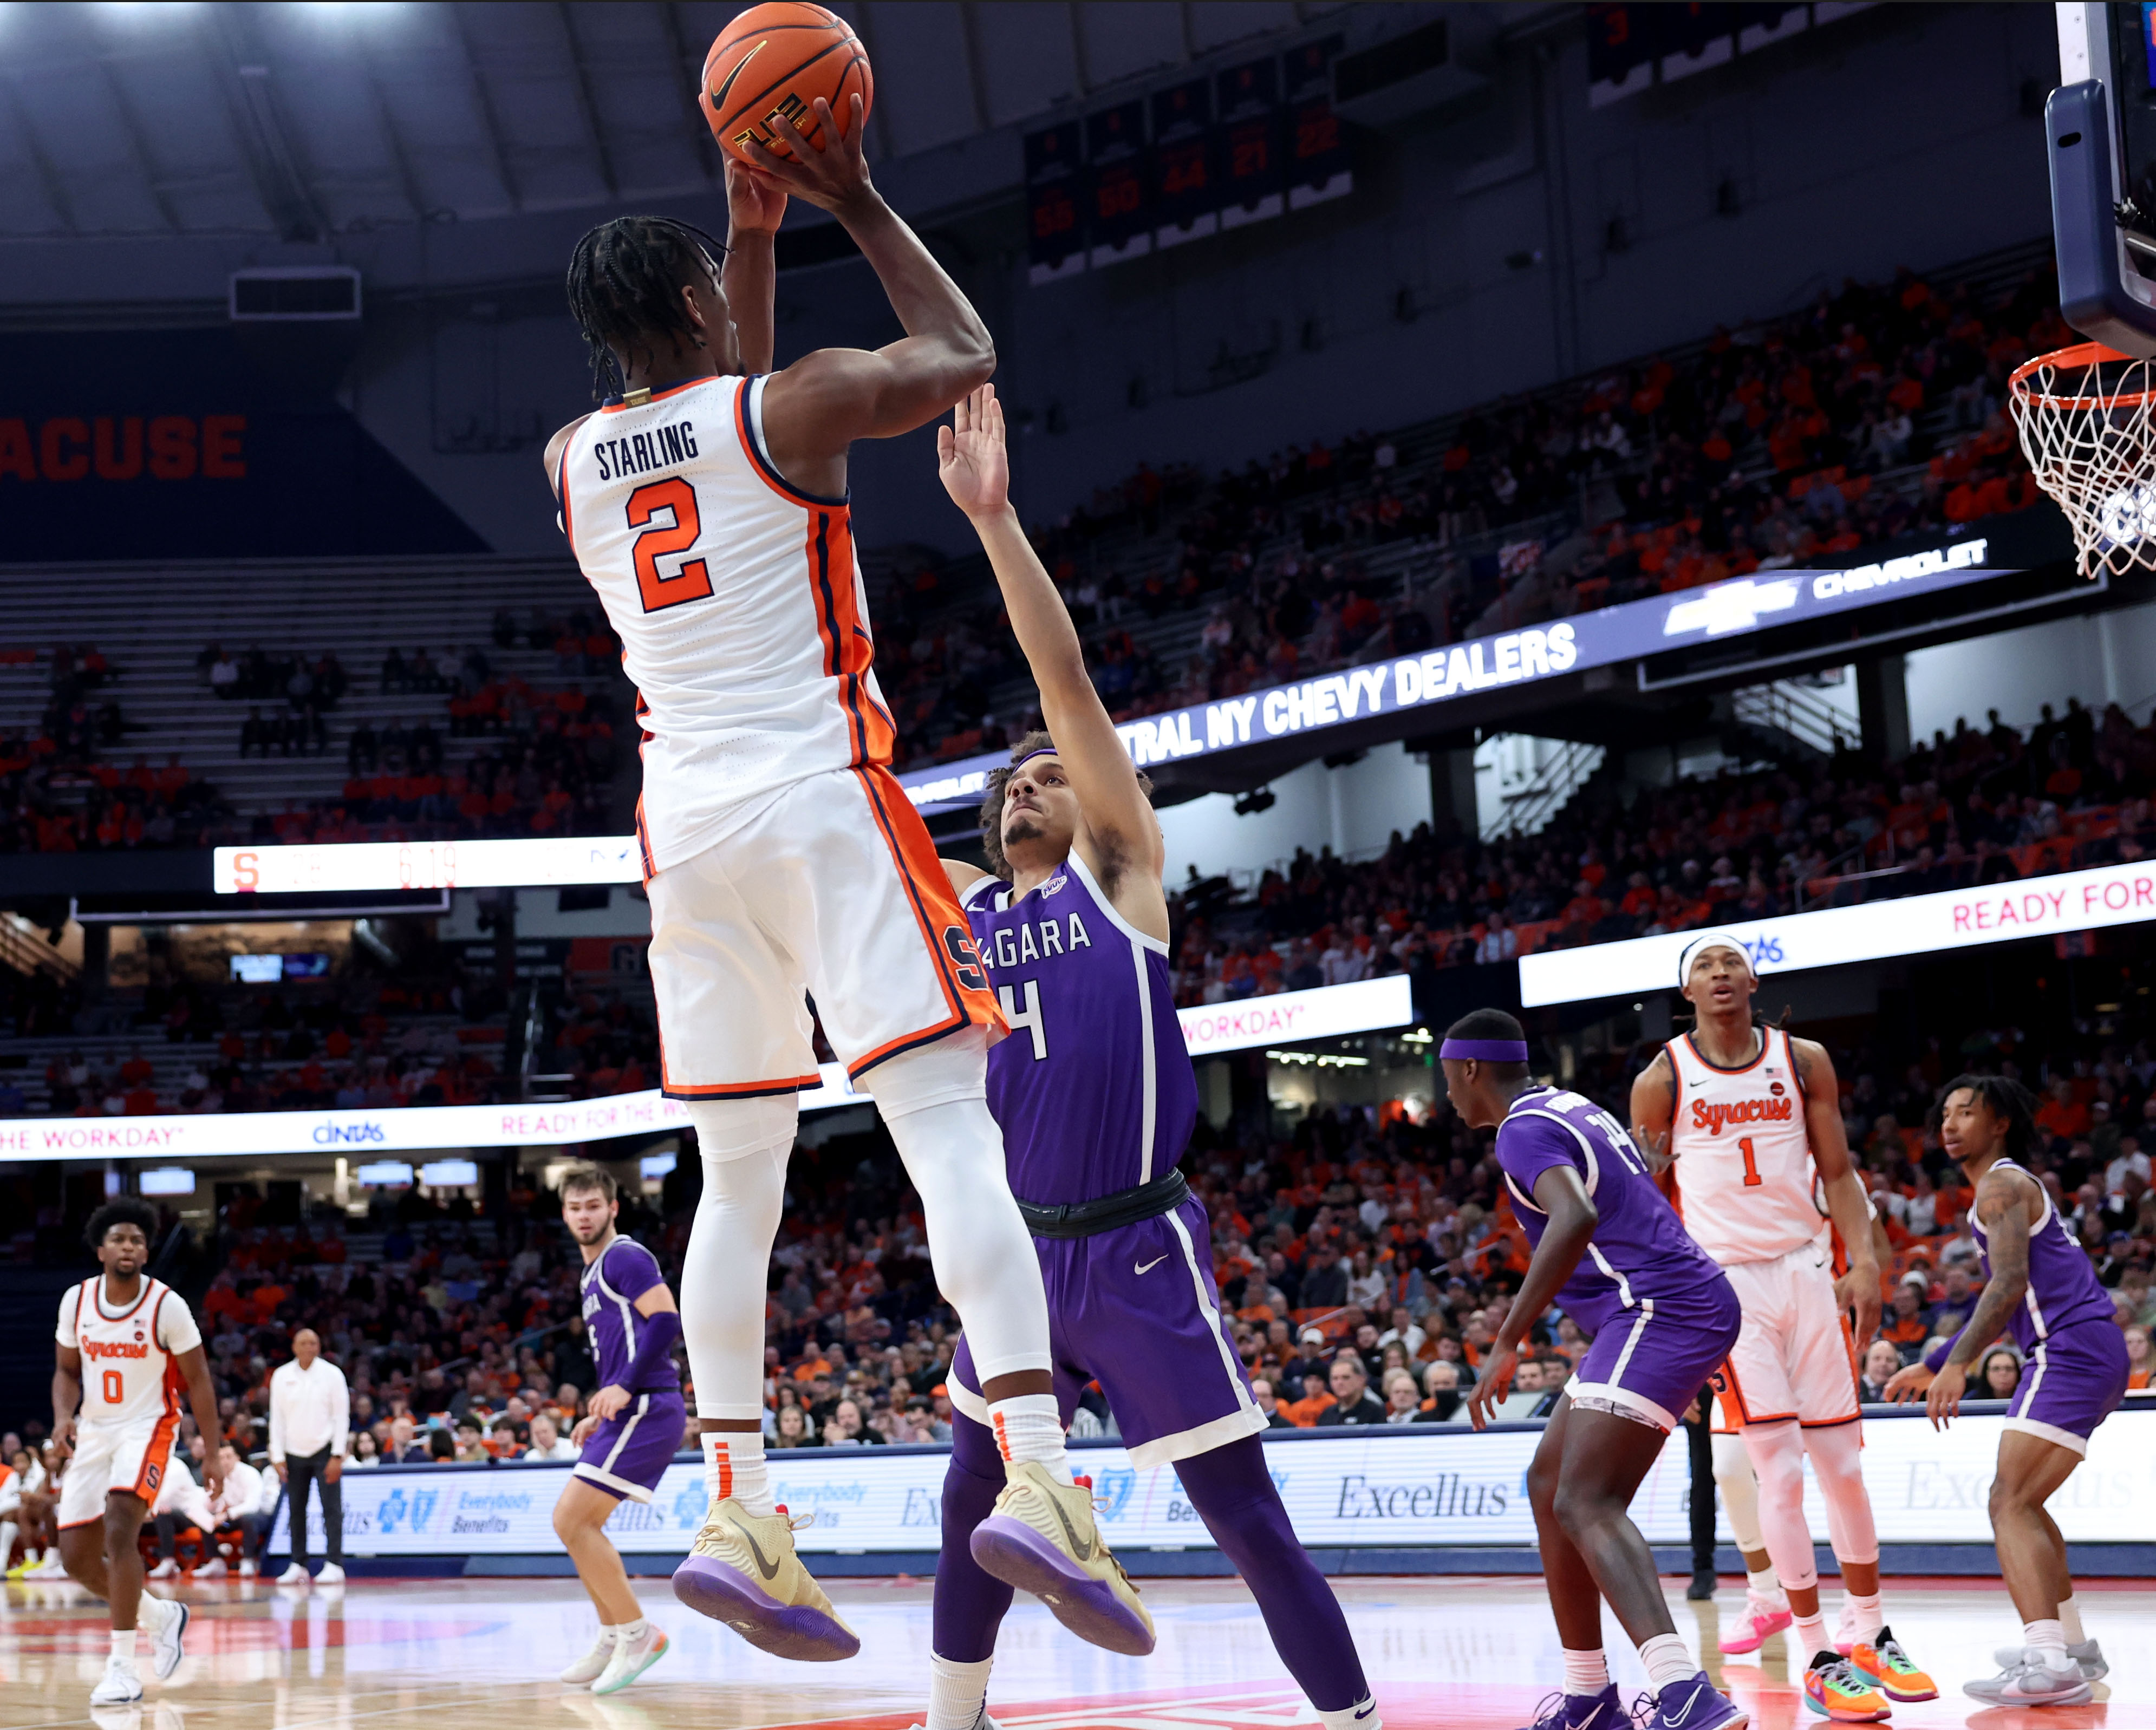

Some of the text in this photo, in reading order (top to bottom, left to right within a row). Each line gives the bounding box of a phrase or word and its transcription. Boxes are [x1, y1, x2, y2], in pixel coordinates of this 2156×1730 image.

[594, 421, 699, 481] STARLING
[625, 475, 715, 614] 2
[1812, 538, 1988, 599] CHEVROLET
[1206, 695, 1258, 748] NY
[1262, 664, 1388, 736] CHEVY
[1394, 622, 1578, 708] DEALERS
[1953, 877, 2154, 932] READY FOR
[942, 925, 989, 991] S
[501, 1113, 578, 1134] READY
[586, 1106, 618, 1128] FOR
[625, 1101, 653, 1123] THE
[1692, 1097, 1792, 1135] Syracuse
[1738, 1137, 1762, 1186] 1
[81, 1335, 148, 1362] Syracuse
[103, 1370, 123, 1403] 0
[774, 1479, 868, 1507] Everybody
[1332, 1473, 1509, 1518] Excellus
[451, 1515, 510, 1534] Benefits
